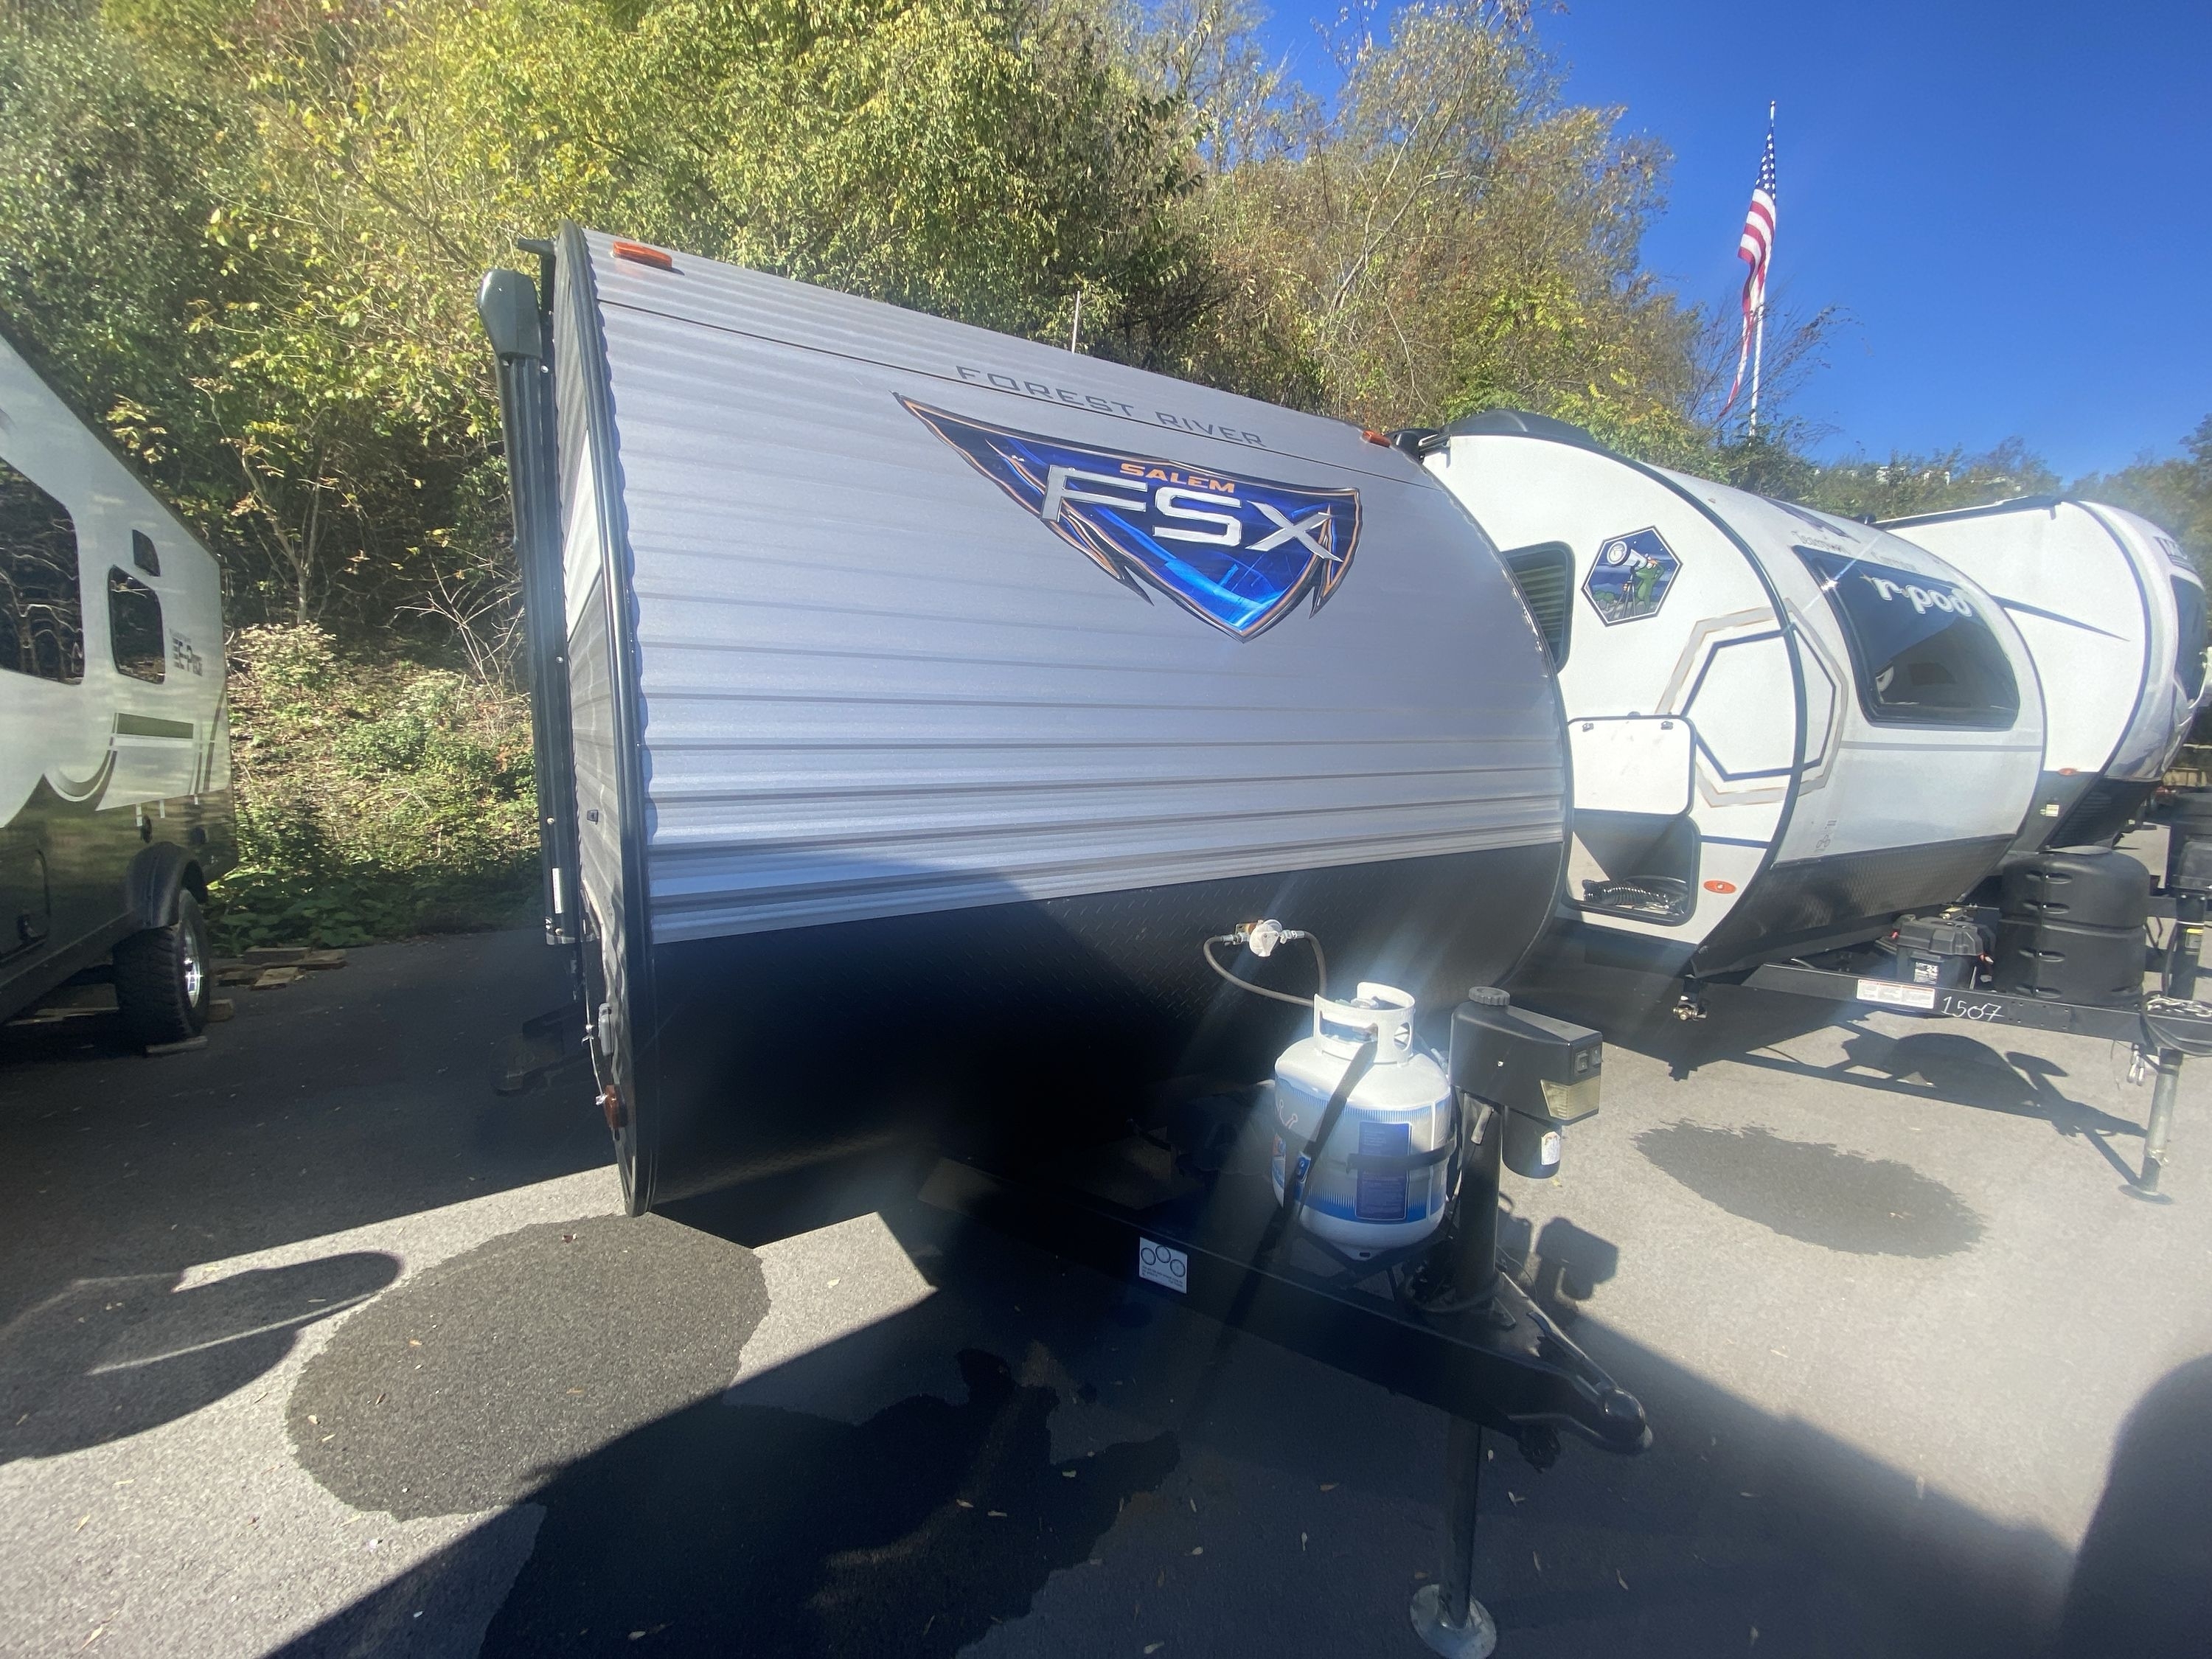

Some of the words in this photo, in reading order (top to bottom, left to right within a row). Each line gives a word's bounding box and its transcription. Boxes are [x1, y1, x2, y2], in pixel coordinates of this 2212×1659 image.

[956, 365, 1134, 417] FOREST
[1155, 411, 1267, 447] RIVER
[1120, 462, 1235, 494] SALEM
[1040, 465, 1344, 563] FSX
[1941, 995, 2005, 1022] 1507
